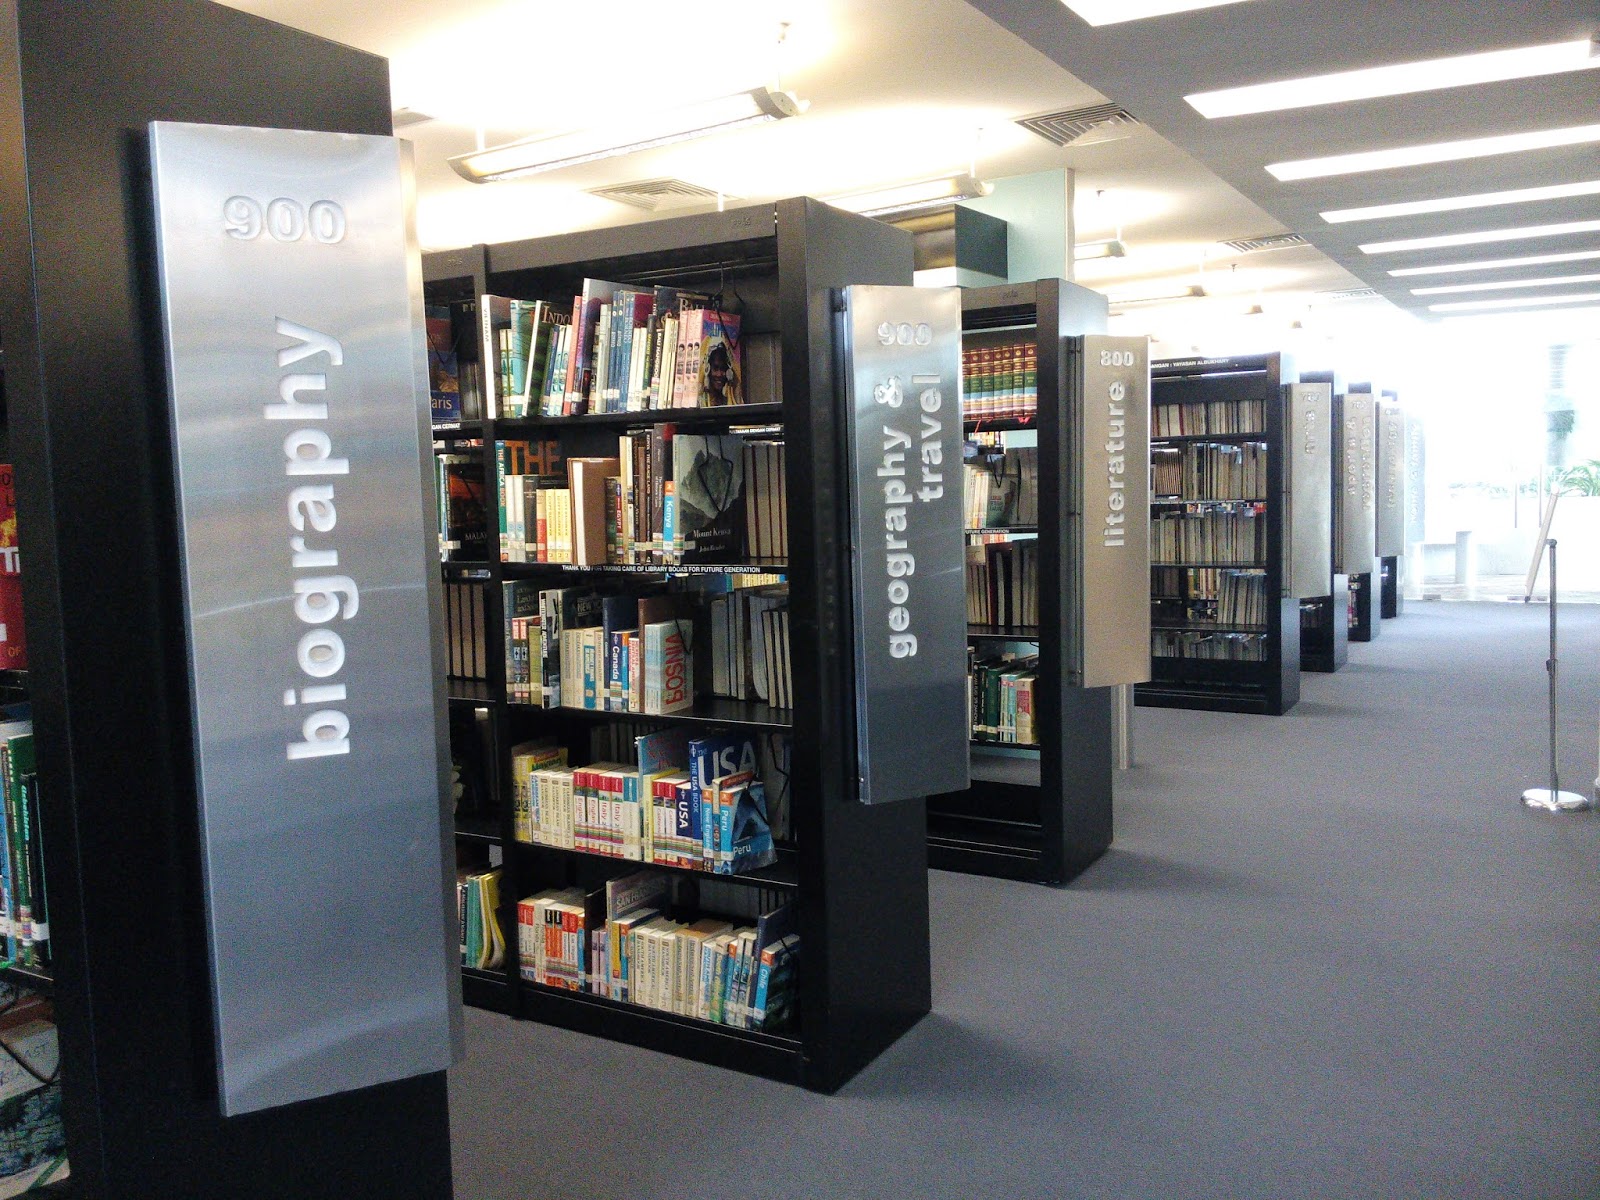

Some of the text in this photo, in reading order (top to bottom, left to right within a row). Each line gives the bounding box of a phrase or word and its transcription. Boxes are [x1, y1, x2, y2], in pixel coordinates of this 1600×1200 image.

[223, 195, 347, 245] 900
[878, 322, 932, 346] 900
[1100, 350, 1134, 367] 800
[431, 396, 453, 410] aris
[912, 374, 944, 503] travel
[504, 440, 563, 476] THE
[1104, 381, 1126, 547] literature
[665, 501, 673, 528] Kenya
[873, 376, 917, 659] geography &
[264, 316, 359, 760] biography
[693, 529, 712, 539] Mount
[724, 566, 760, 574] GENERATION
[665, 633, 685, 705] BOSNIA
[697, 741, 757, 789] USA
[679, 801, 688, 828] USA
[704, 824, 712, 848] Englan
[733, 844, 752, 857] Peru
[760, 969, 768, 989] Chile
